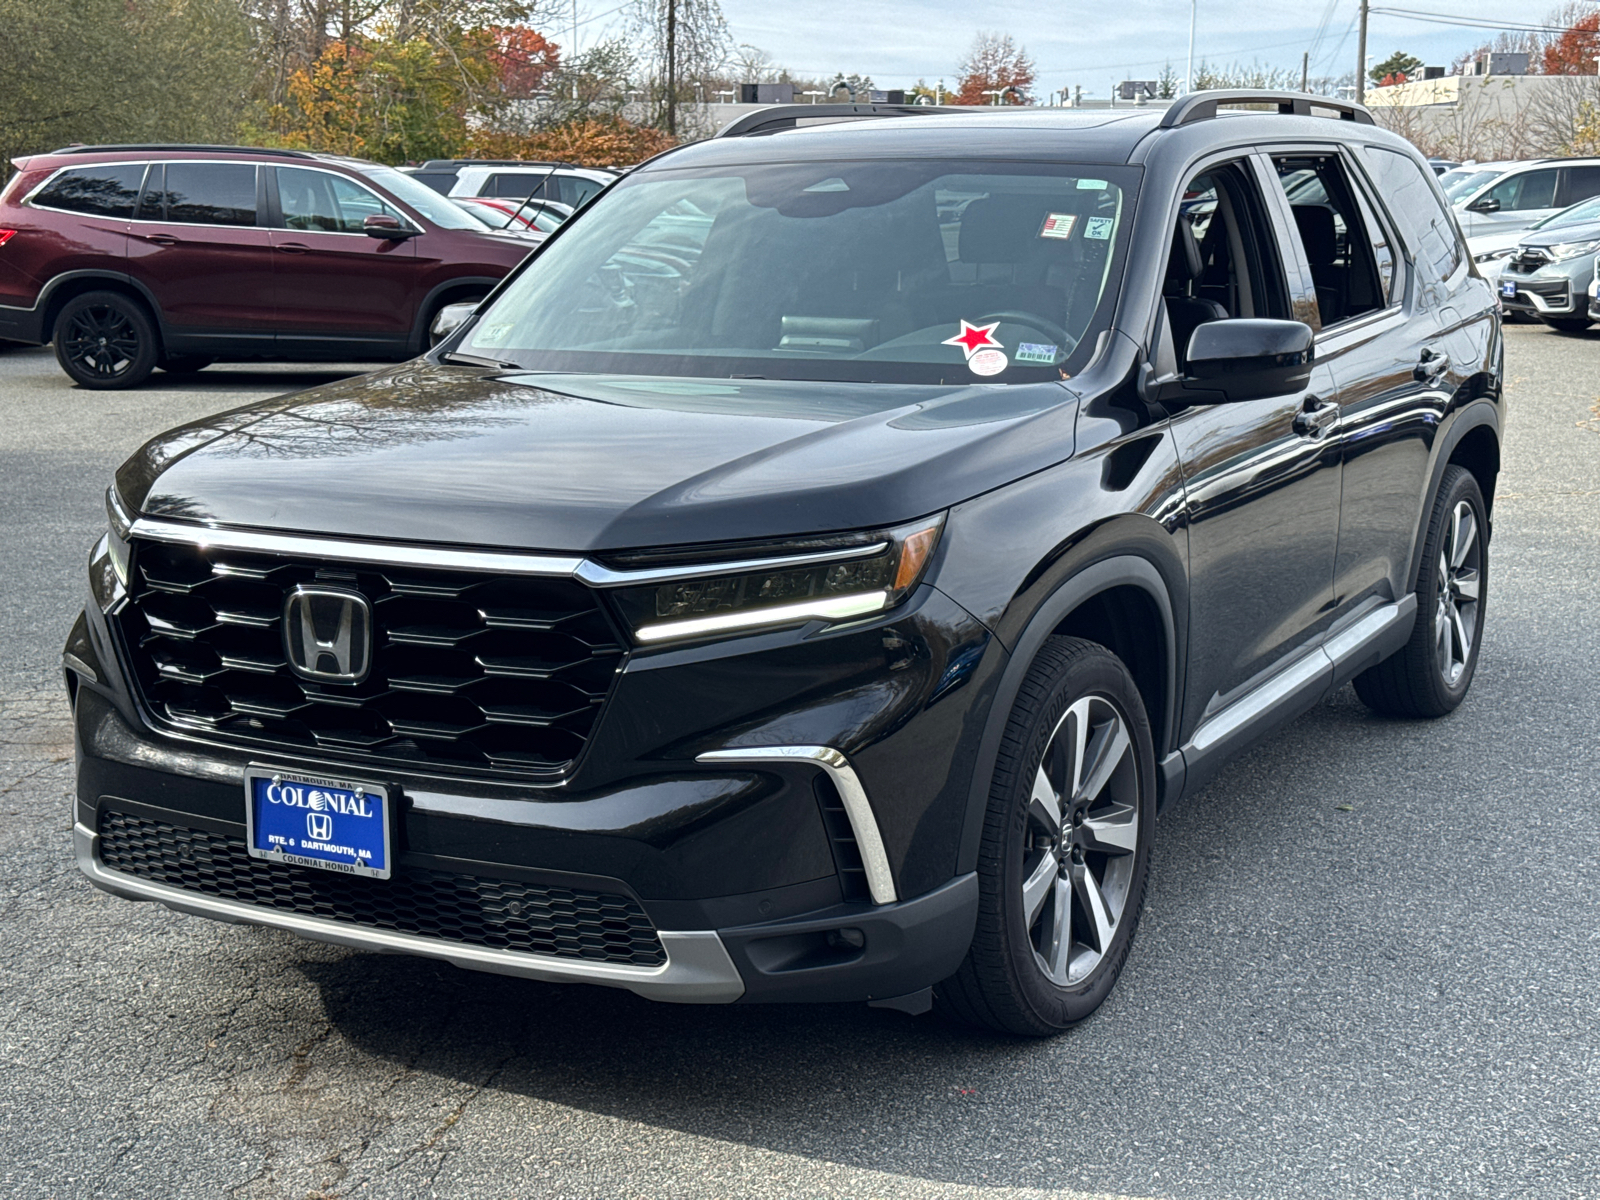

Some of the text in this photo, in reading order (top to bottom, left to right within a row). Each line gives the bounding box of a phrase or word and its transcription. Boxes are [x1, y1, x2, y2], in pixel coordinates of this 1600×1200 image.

[339, 781, 353, 790] MA
[266, 784, 373, 818] COLONIAL
[268, 834, 372, 860] RTE. 6 DARTMOUTH, MA
[282, 854, 356, 874] COLONIAL HONDA
